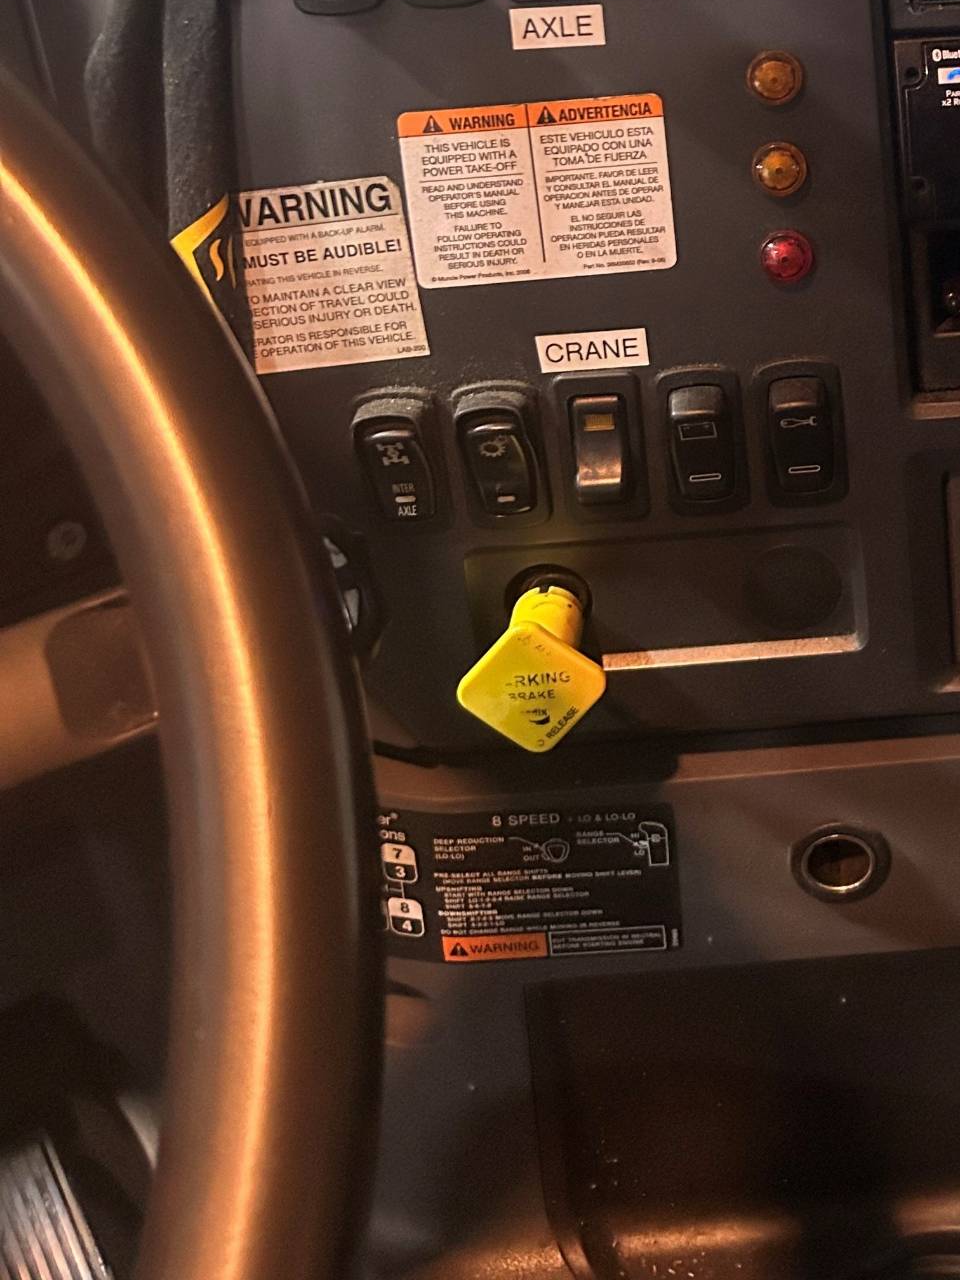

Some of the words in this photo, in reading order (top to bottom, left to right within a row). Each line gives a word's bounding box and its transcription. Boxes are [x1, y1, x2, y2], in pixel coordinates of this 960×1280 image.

[523, 15, 593, 39] AXLE
[558, 101, 653, 122] ADVERTENCIA
[448, 113, 516, 130] WARNING
[540, 134, 568, 144] ESTE
[569, 128, 625, 141] VEHICULO
[627, 127, 654, 137] ESTA
[424, 143, 450, 153] THIS
[451, 140, 497, 152] VEHICLE
[500, 138, 511, 148] IS
[543, 142, 599, 155] EQUIPADO
[601, 141, 626, 150] CON
[628, 138, 653, 148] UNA
[421, 153, 476, 165] EQUIPPED
[478, 150, 506, 160] WITH
[509, 150, 518, 158] A
[552, 156, 585, 166] TOMA
[587, 153, 602, 163] DE
[604, 151, 648, 162] FUERZA
[423, 166, 463, 177] POWER
[464, 161, 517, 174] TAKE-OFF
[422, 185, 445, 193] READ
[447, 183, 465, 192] AND
[467, 179, 523, 190] UNDERSTAND
[444, 200, 478, 210] BEFORE
[480, 198, 506, 207] USING
[444, 210, 464, 220] THIS
[454, 223, 488, 232] FAILURE
[490, 222, 503, 230] TO
[436, 233, 472, 243] FOLLOW
[474, 229, 522, 240] OPERATING
[434, 240, 496, 252] INSTRUCTIONS
[497, 238, 527, 247] COULD
[243, 252, 289, 269] MUST
[294, 249, 318, 264] BE
[323, 238, 402, 260] AUDIBLE!
[439, 252, 470, 261] RESULT
[482, 248, 510, 258] DEATH
[511, 247, 525, 255] OR
[447, 259, 486, 269] SERIOUS
[297, 270, 331, 280] VEHICLE
[262, 288, 319, 303] MAINTAIN
[322, 287, 331, 296] A
[333, 281, 373, 295] CLEAR
[375, 278, 406, 289] VIEW
[300, 301, 316, 311] OF
[318, 296, 365, 309] TRAVEL
[368, 290, 409, 303] COULD
[254, 316, 306, 329] SERIOUS
[308, 310, 351, 323] INJURY
[353, 307, 372, 318] OR
[374, 302, 417, 316] DEATH.
[296, 333, 307, 341] IS
[308, 323, 382, 340] RESPONSIBLE
[384, 320, 407, 331] FOR
[260, 343, 322, 358] OPERATION
[324, 341, 339, 350] OF
[342, 337, 366, 347] THIS
[368, 331, 416, 345] VEHICLE.
[545, 338, 639, 363] CRANE
[398, 505, 418, 517] AXLE
[545, 705, 579, 739] RELEASE
[492, 815, 502, 827] 8
[508, 813, 560, 826] SPEED
[392, 847, 403, 859] 7
[395, 865, 406, 878] 3
[400, 901, 410, 914] 8
[402, 919, 413, 932] 4
[469, 941, 539, 953] WARNING
